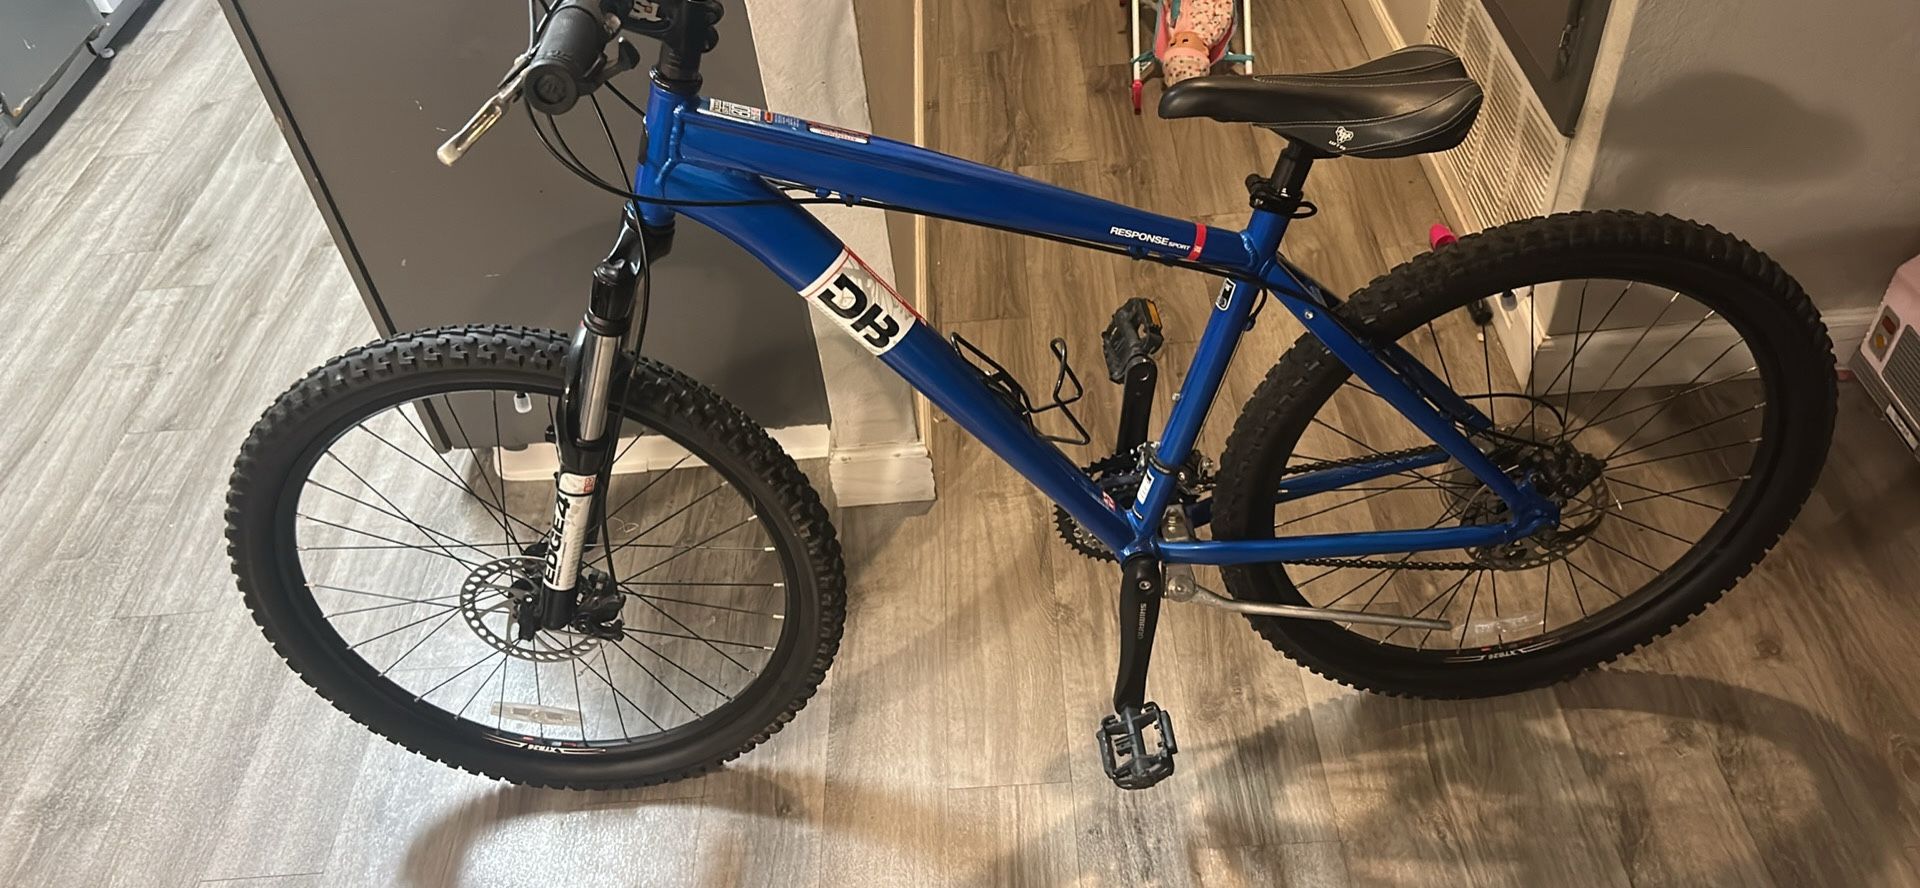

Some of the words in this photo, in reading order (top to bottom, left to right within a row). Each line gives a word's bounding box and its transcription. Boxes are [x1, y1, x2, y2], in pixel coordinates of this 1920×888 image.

[1110, 226, 1169, 246] RESPONSE
[1168, 241, 1191, 251] SPORT
[545, 491, 571, 585] EDGE4
